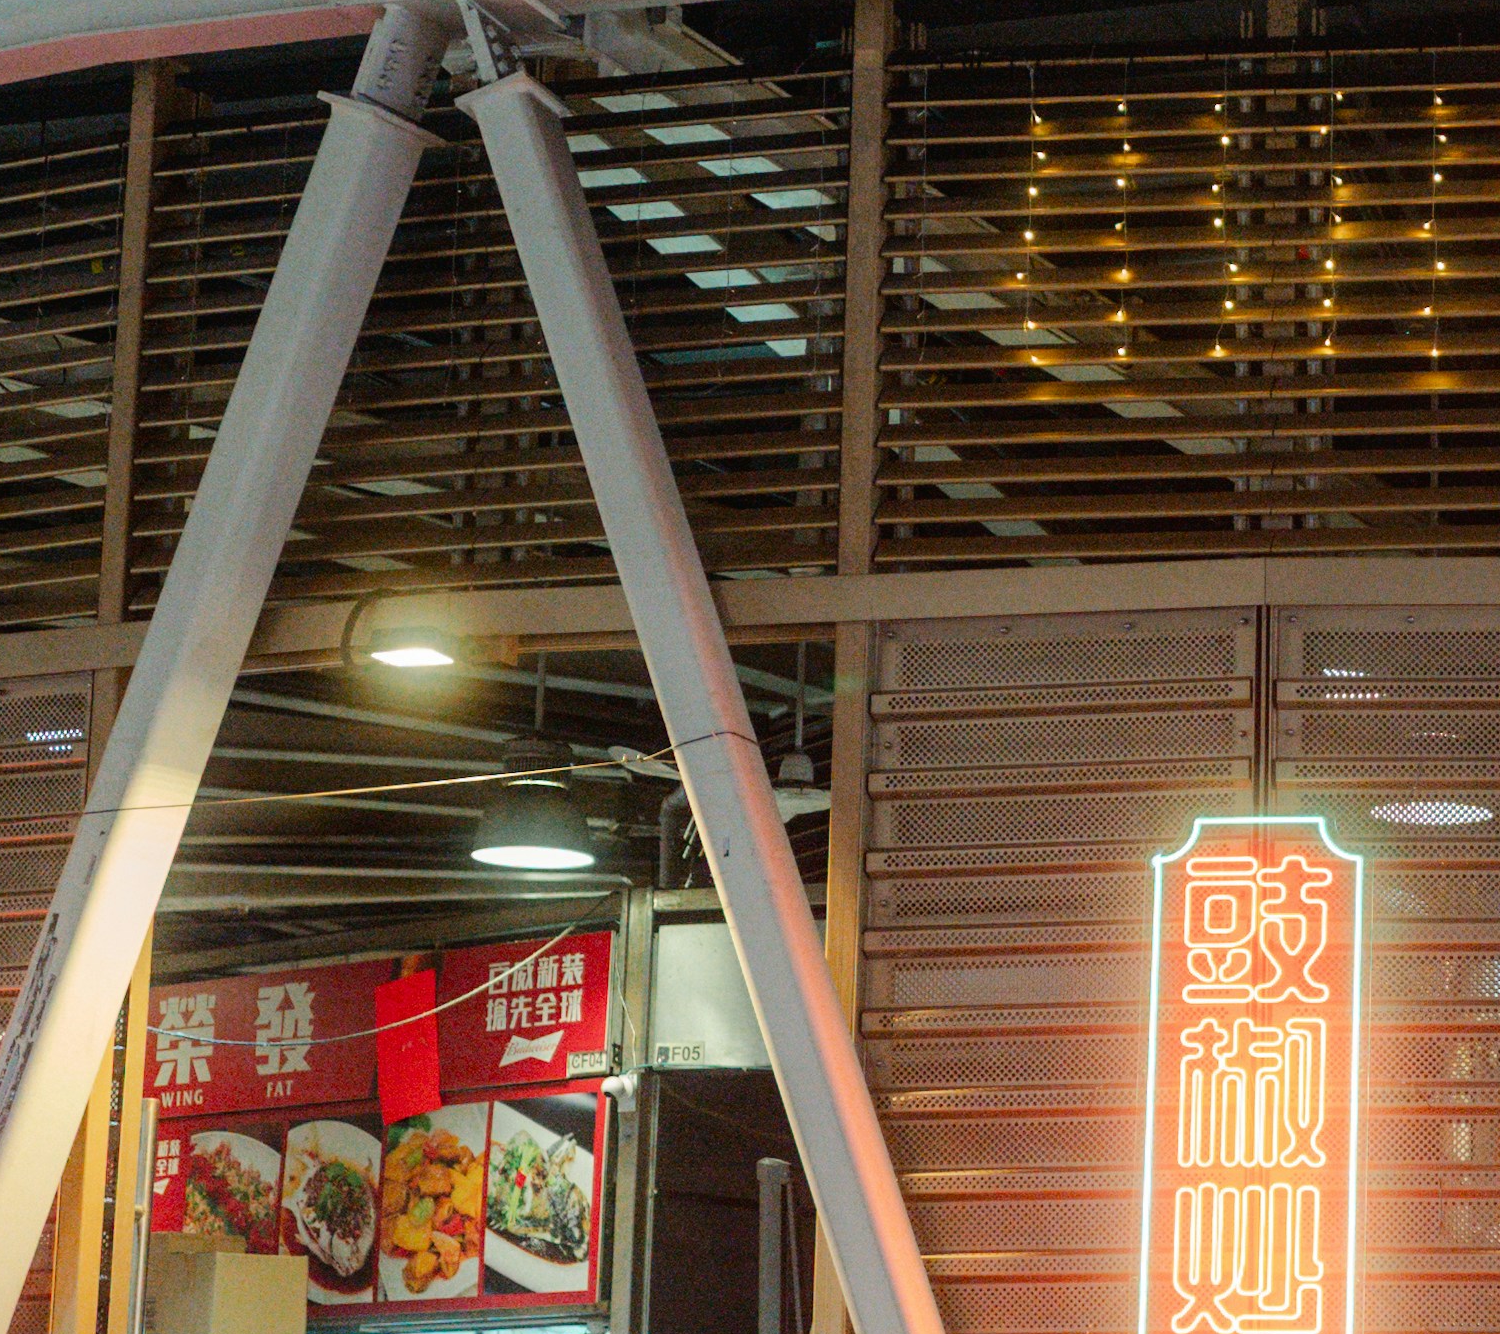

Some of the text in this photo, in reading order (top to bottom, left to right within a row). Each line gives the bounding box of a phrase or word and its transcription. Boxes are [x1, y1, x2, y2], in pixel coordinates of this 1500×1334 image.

[485, 987, 584, 1033] 搶先全球
[153, 981, 316, 1088] 榮發
[571, 1052, 606, 1069] CF04
[658, 1045, 701, 1063] F05
[161, 1079, 294, 1108] WING FAT
